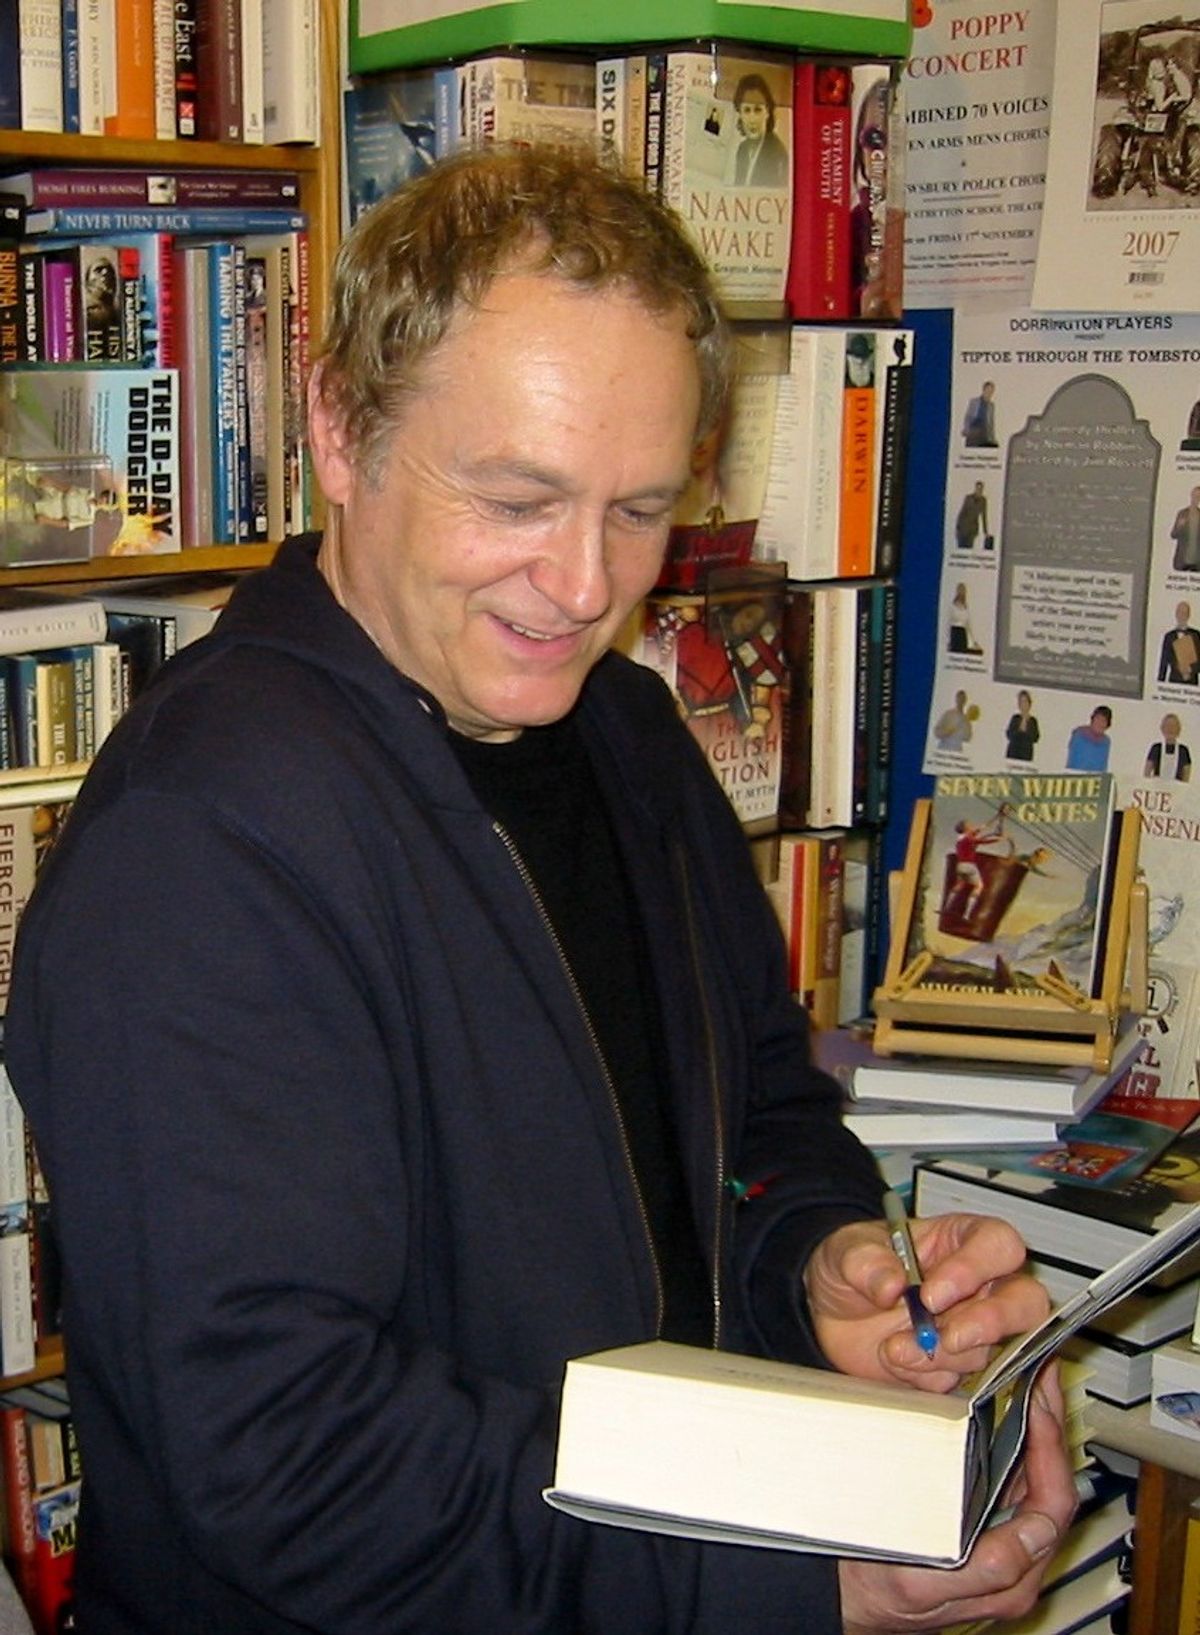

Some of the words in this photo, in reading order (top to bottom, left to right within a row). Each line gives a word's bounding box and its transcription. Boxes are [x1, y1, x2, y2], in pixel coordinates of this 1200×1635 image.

[175, 19, 195, 62] East
[951, 10, 1030, 40] POPPY
[907, 45, 1028, 79] CONCERT
[602, 69, 616, 113] SIX
[672, 64, 685, 138] NANCY
[972, 104, 988, 119] 70
[992, 96, 1049, 116] VOICES
[820, 125, 830, 145] OF
[929, 136, 963, 150] ARMS
[966, 134, 1000, 148] MENS
[820, 149, 831, 199] YOUTH
[833, 119, 843, 205] TESTAMENT
[38, 184, 68, 195] HOME
[71, 184, 97, 195] FIRES
[962, 178, 1007, 191] POLICE
[66, 214, 111, 230] NEVER
[116, 214, 152, 230] TURN
[156, 214, 190, 230] BACK
[690, 192, 788, 225] NANCY
[701, 227, 774, 259] WAKE
[1122, 231, 1180, 258] 2007
[0, 252, 18, 308] BURMA
[24, 262, 35, 290] THE
[218, 256, 232, 319] TAMING
[26, 293, 37, 343] WORLD
[1009, 318, 1103, 332] DORRINGTON
[1106, 315, 1173, 330] PLAYERS
[2, 324, 16, 346] THE
[220, 324, 233, 353] THE
[962, 350, 1012, 363] TIPTOE
[1017, 350, 1088, 363] THROUGH
[1093, 350, 1122, 363] THE
[152, 374, 172, 432] THE
[127, 387, 149, 516] DODGER
[854, 396, 868, 494] DARWIN
[151, 439, 173, 536] D-DAY
[936, 775, 1014, 799] SEVEN
[1022, 775, 1100, 799] WHITE
[1132, 788, 1172, 814] SUE
[1018, 802, 1098, 825] GATES
[0, 823, 14, 913] FIERCE
